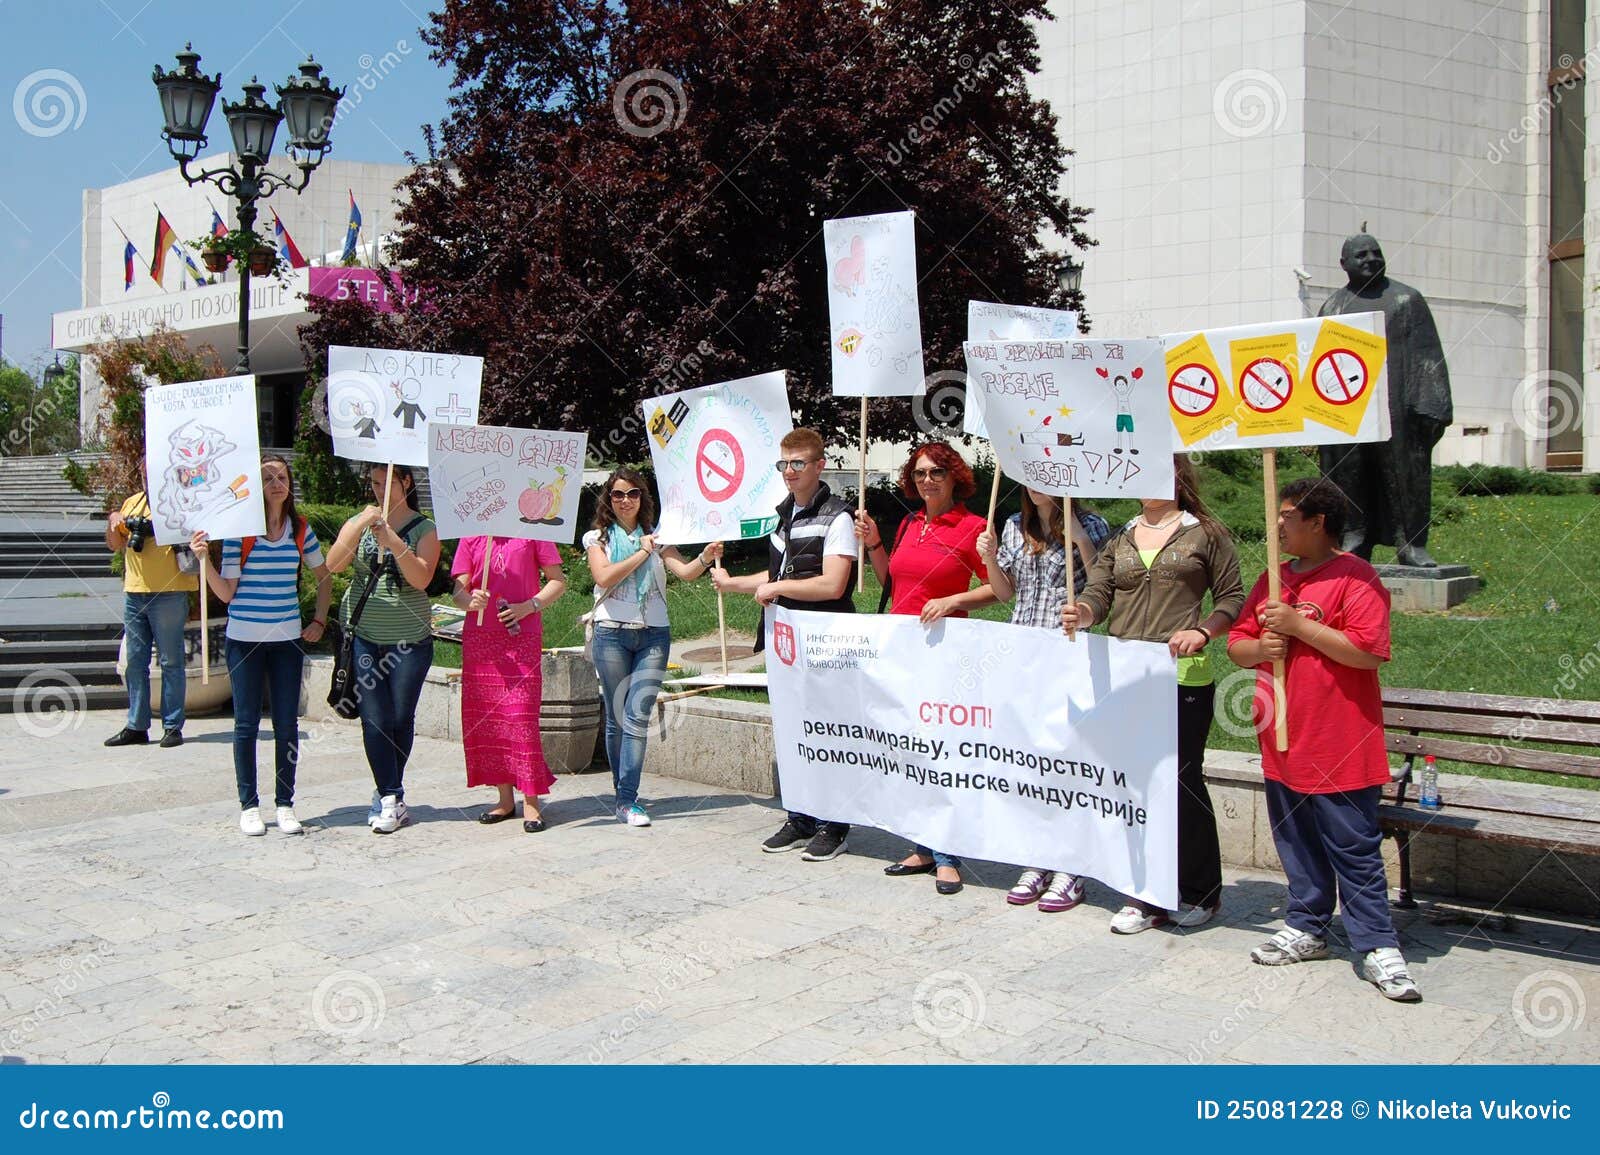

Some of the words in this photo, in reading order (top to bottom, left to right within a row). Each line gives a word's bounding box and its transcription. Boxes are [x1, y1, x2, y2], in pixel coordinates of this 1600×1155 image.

[360, 353, 461, 379] ДОКЛЕ?
[857, 634, 870, 645] ЗА
[836, 648, 879, 660] ЗДРАВЉЕ
[919, 701, 992, 729] СТОП!
[803, 719, 949, 761] рекламирању,
[959, 742, 1105, 786] спонзорству
[1113, 769, 1127, 788] и
[797, 742, 900, 776] промоцији
[905, 763, 1010, 793] дуванске
[1016, 782, 1147, 827] индустрије
